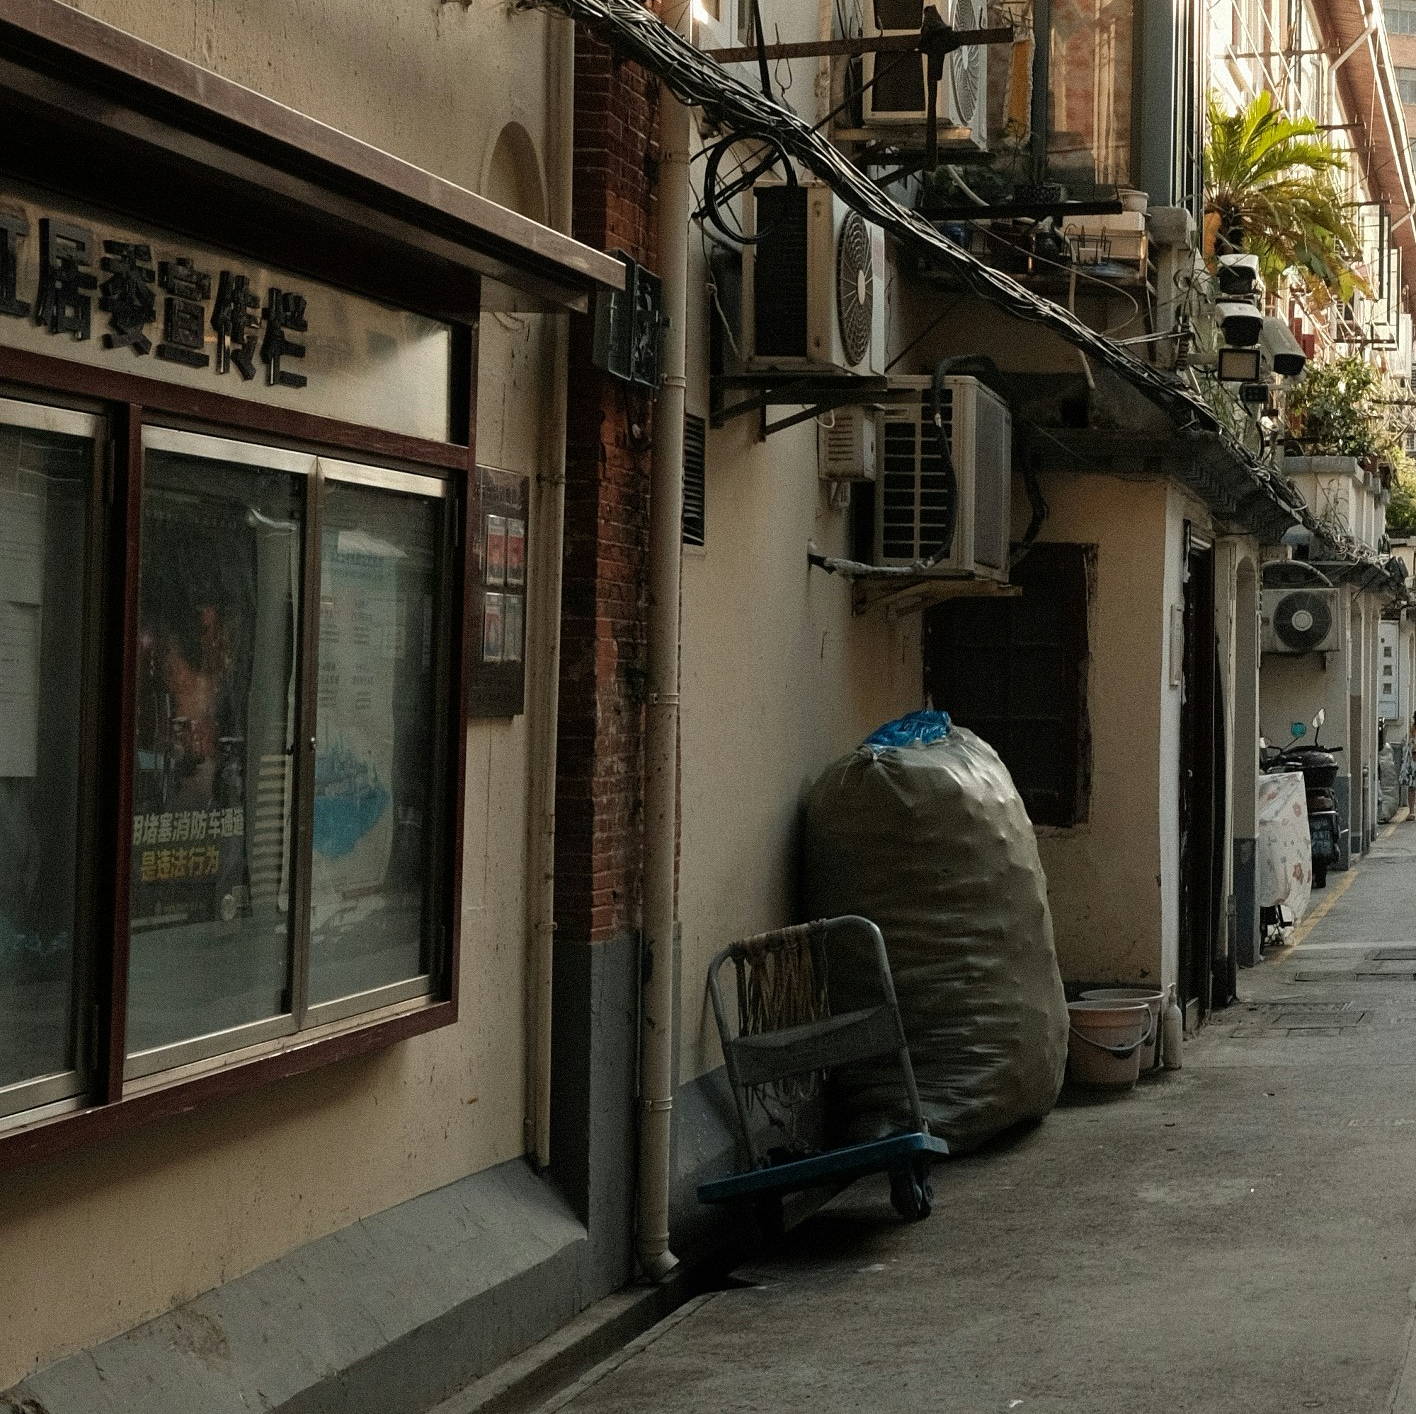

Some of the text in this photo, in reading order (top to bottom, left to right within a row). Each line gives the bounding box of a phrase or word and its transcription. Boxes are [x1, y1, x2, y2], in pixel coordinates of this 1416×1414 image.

[140, 845, 220, 883] 是违法行为
